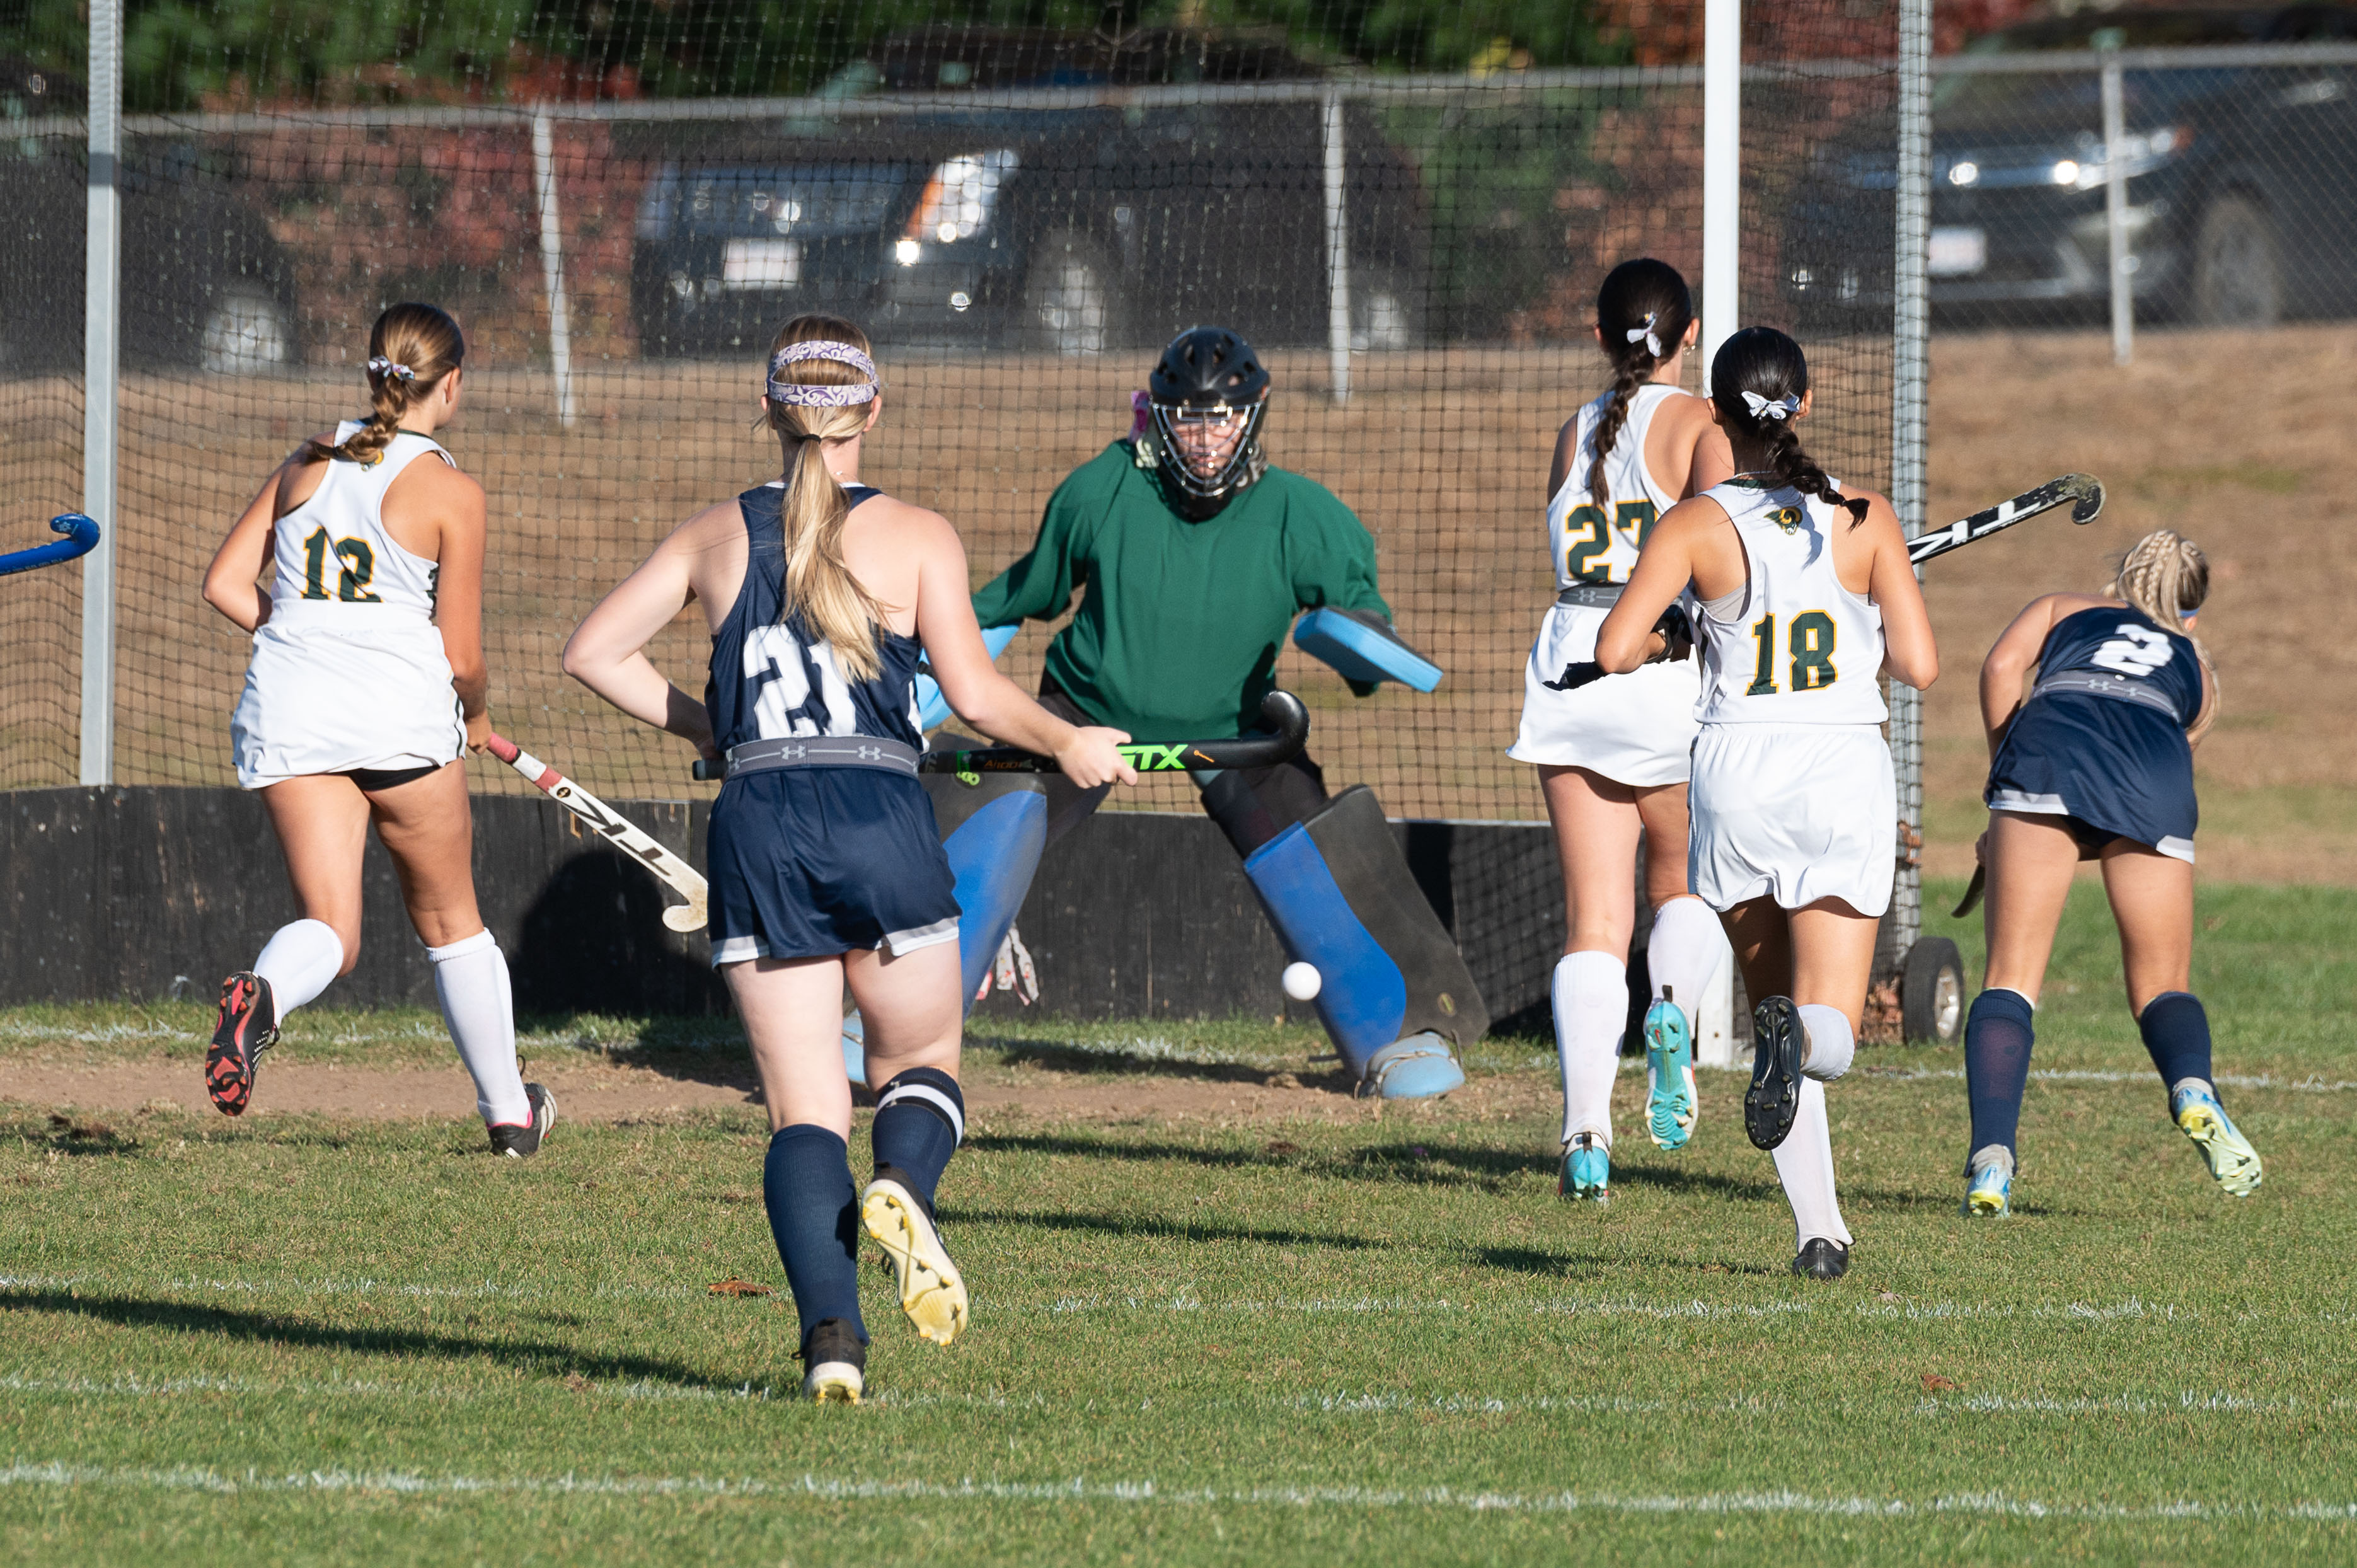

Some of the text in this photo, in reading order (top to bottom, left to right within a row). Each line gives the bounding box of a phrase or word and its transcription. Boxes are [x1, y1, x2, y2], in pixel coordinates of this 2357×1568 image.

[301, 526, 384, 602] 12
[1565, 499, 1658, 582] 27
[744, 624, 861, 740] 21
[1744, 609, 1838, 696] 18
[2090, 623, 2174, 677] 2
